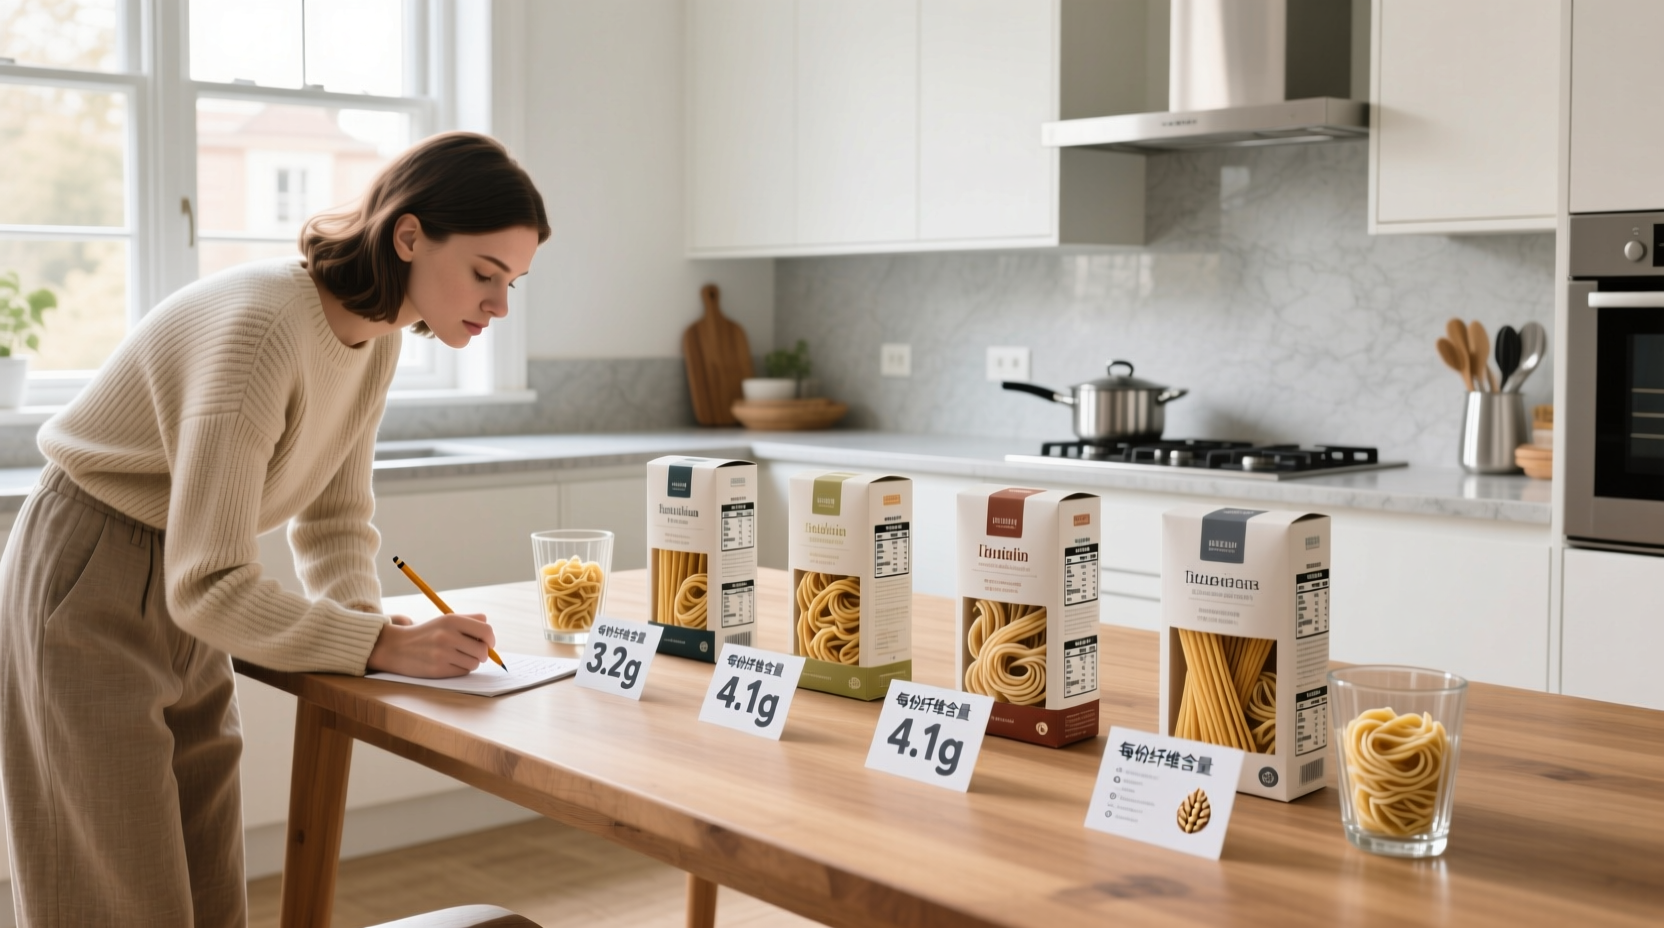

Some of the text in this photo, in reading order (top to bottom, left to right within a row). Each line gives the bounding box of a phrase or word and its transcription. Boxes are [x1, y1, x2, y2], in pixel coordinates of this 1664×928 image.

[586, 642, 641, 689] 3.2g
[716, 676, 779, 727] 4.1g
[887, 718, 963, 776] 4.1g
[1119, 742, 1213, 776] 每份纤维含量
